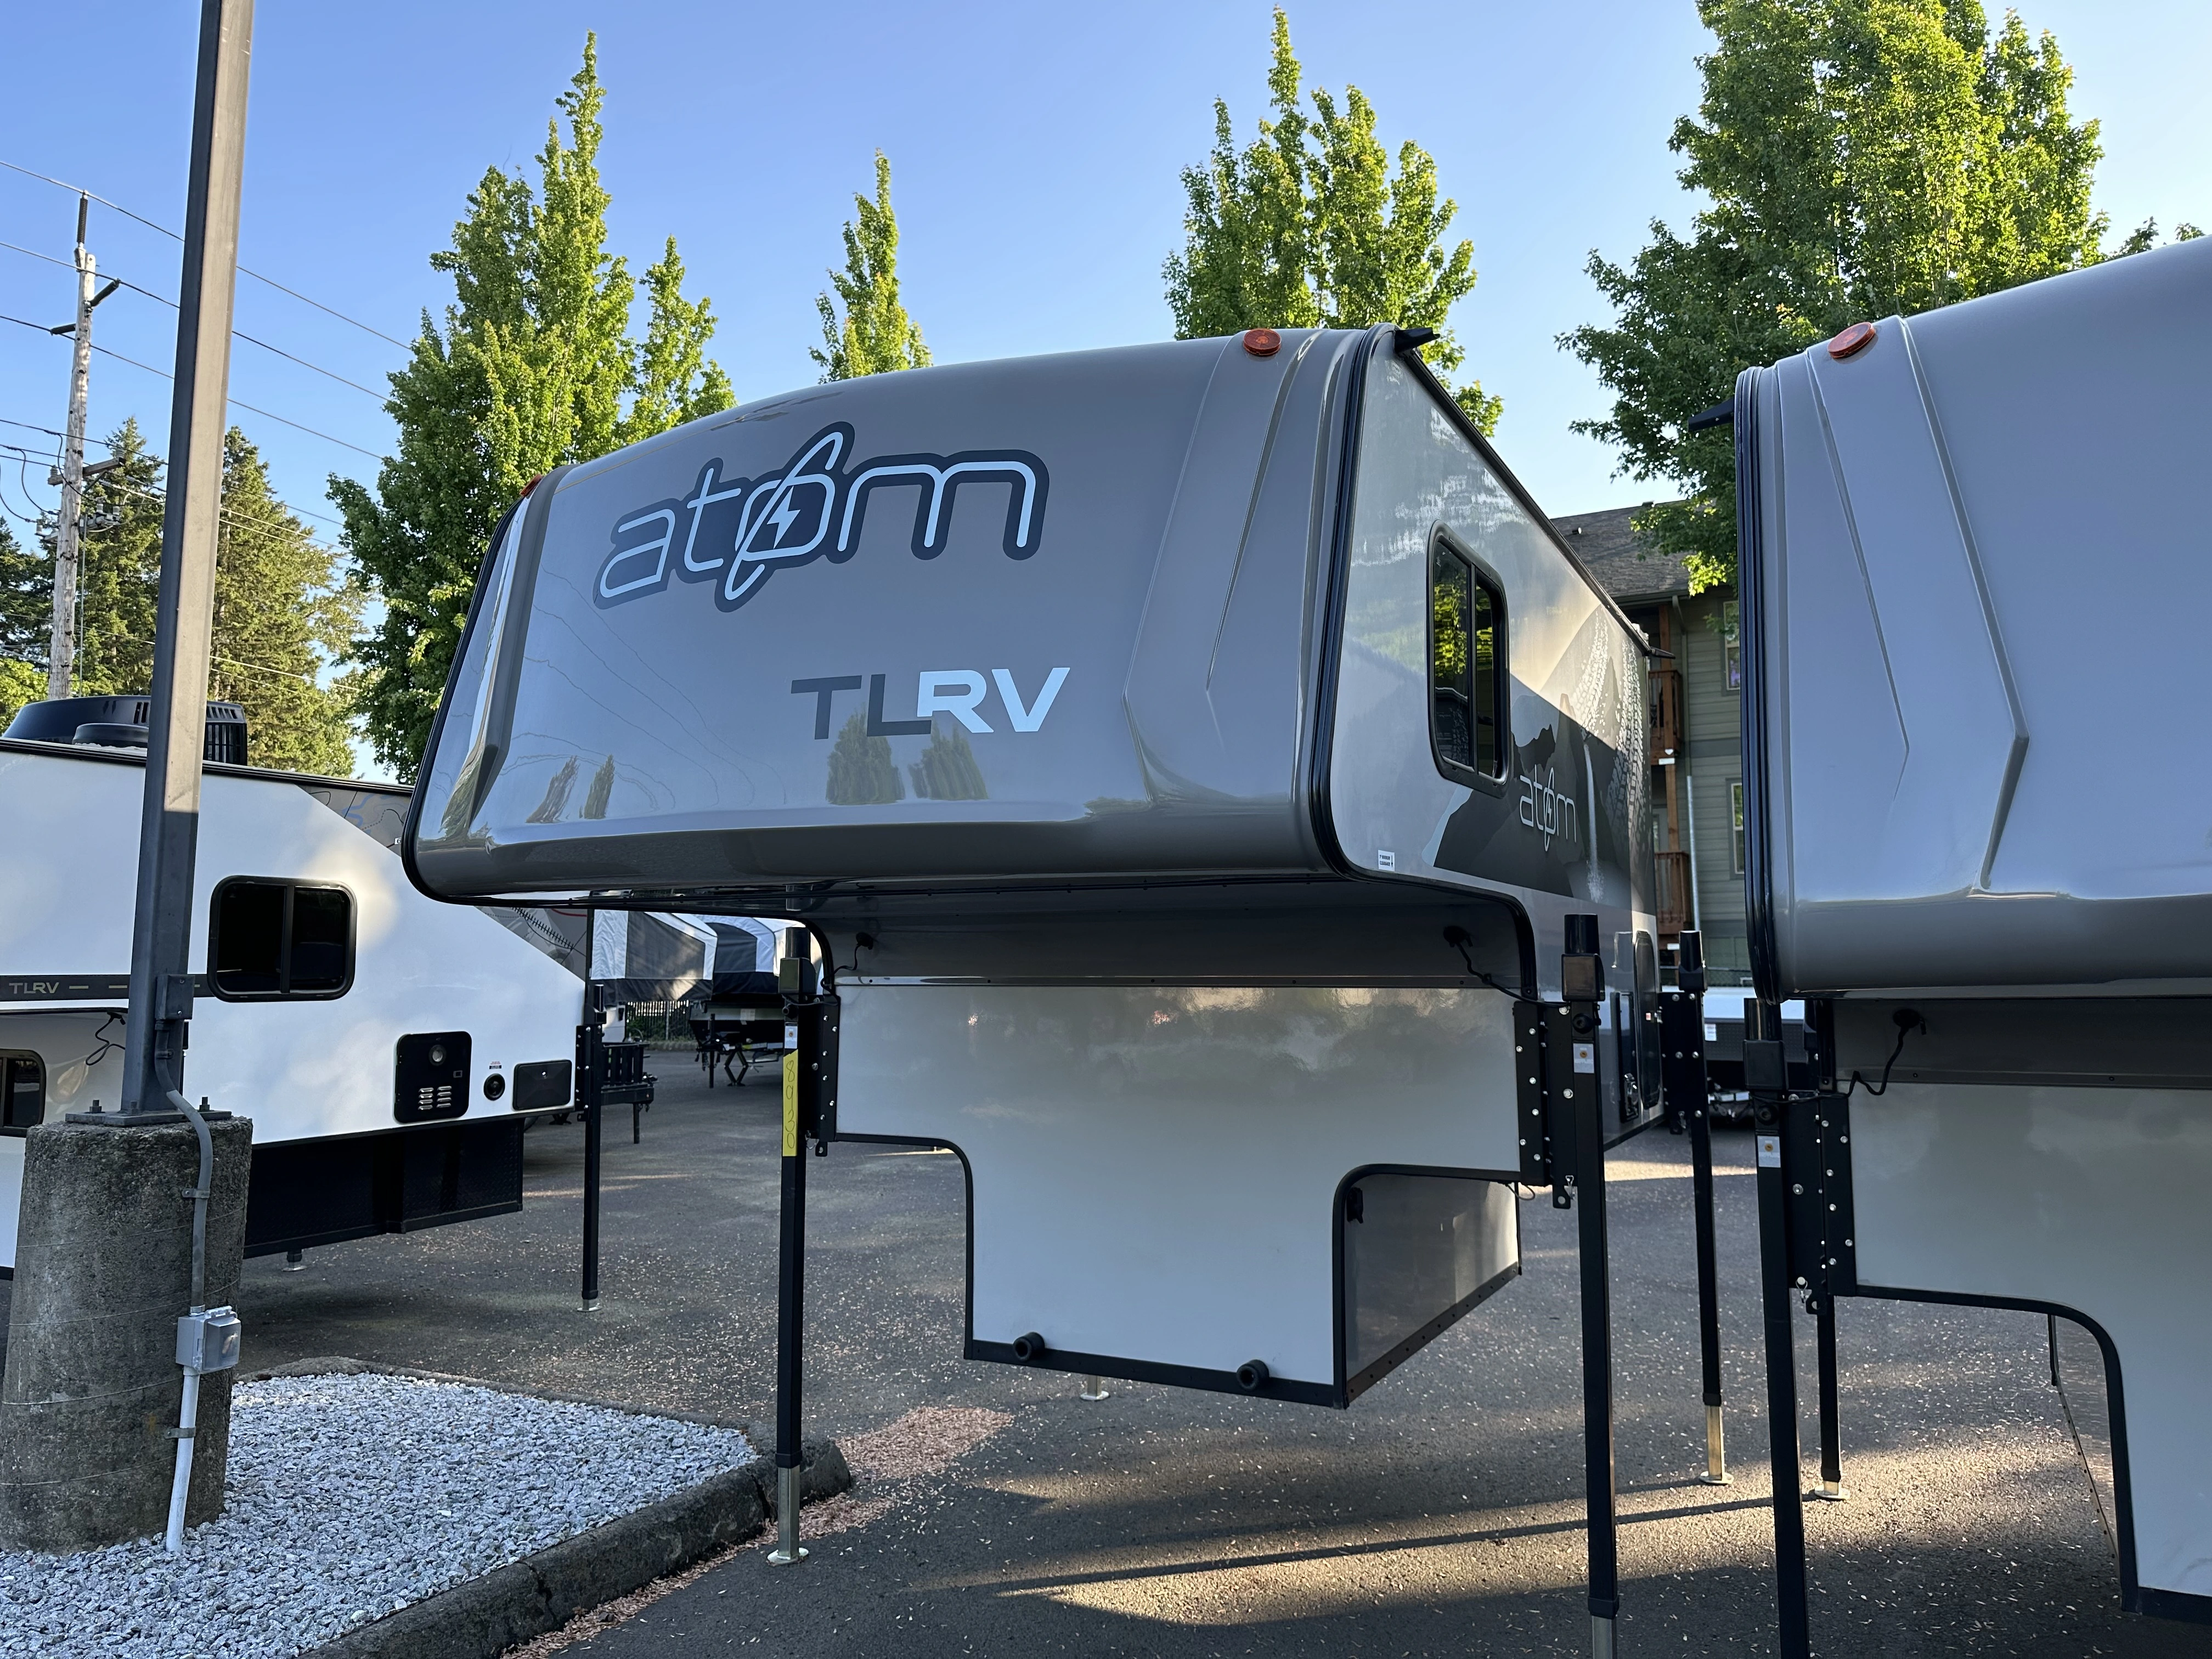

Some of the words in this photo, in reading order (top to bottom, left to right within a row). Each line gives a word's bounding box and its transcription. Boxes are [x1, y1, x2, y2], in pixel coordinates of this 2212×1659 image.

[594, 421, 1049, 612] atom
[791, 667, 1070, 740] TLRV
[1520, 764, 1577, 851] atom
[9, 982, 59, 994] TLRV
